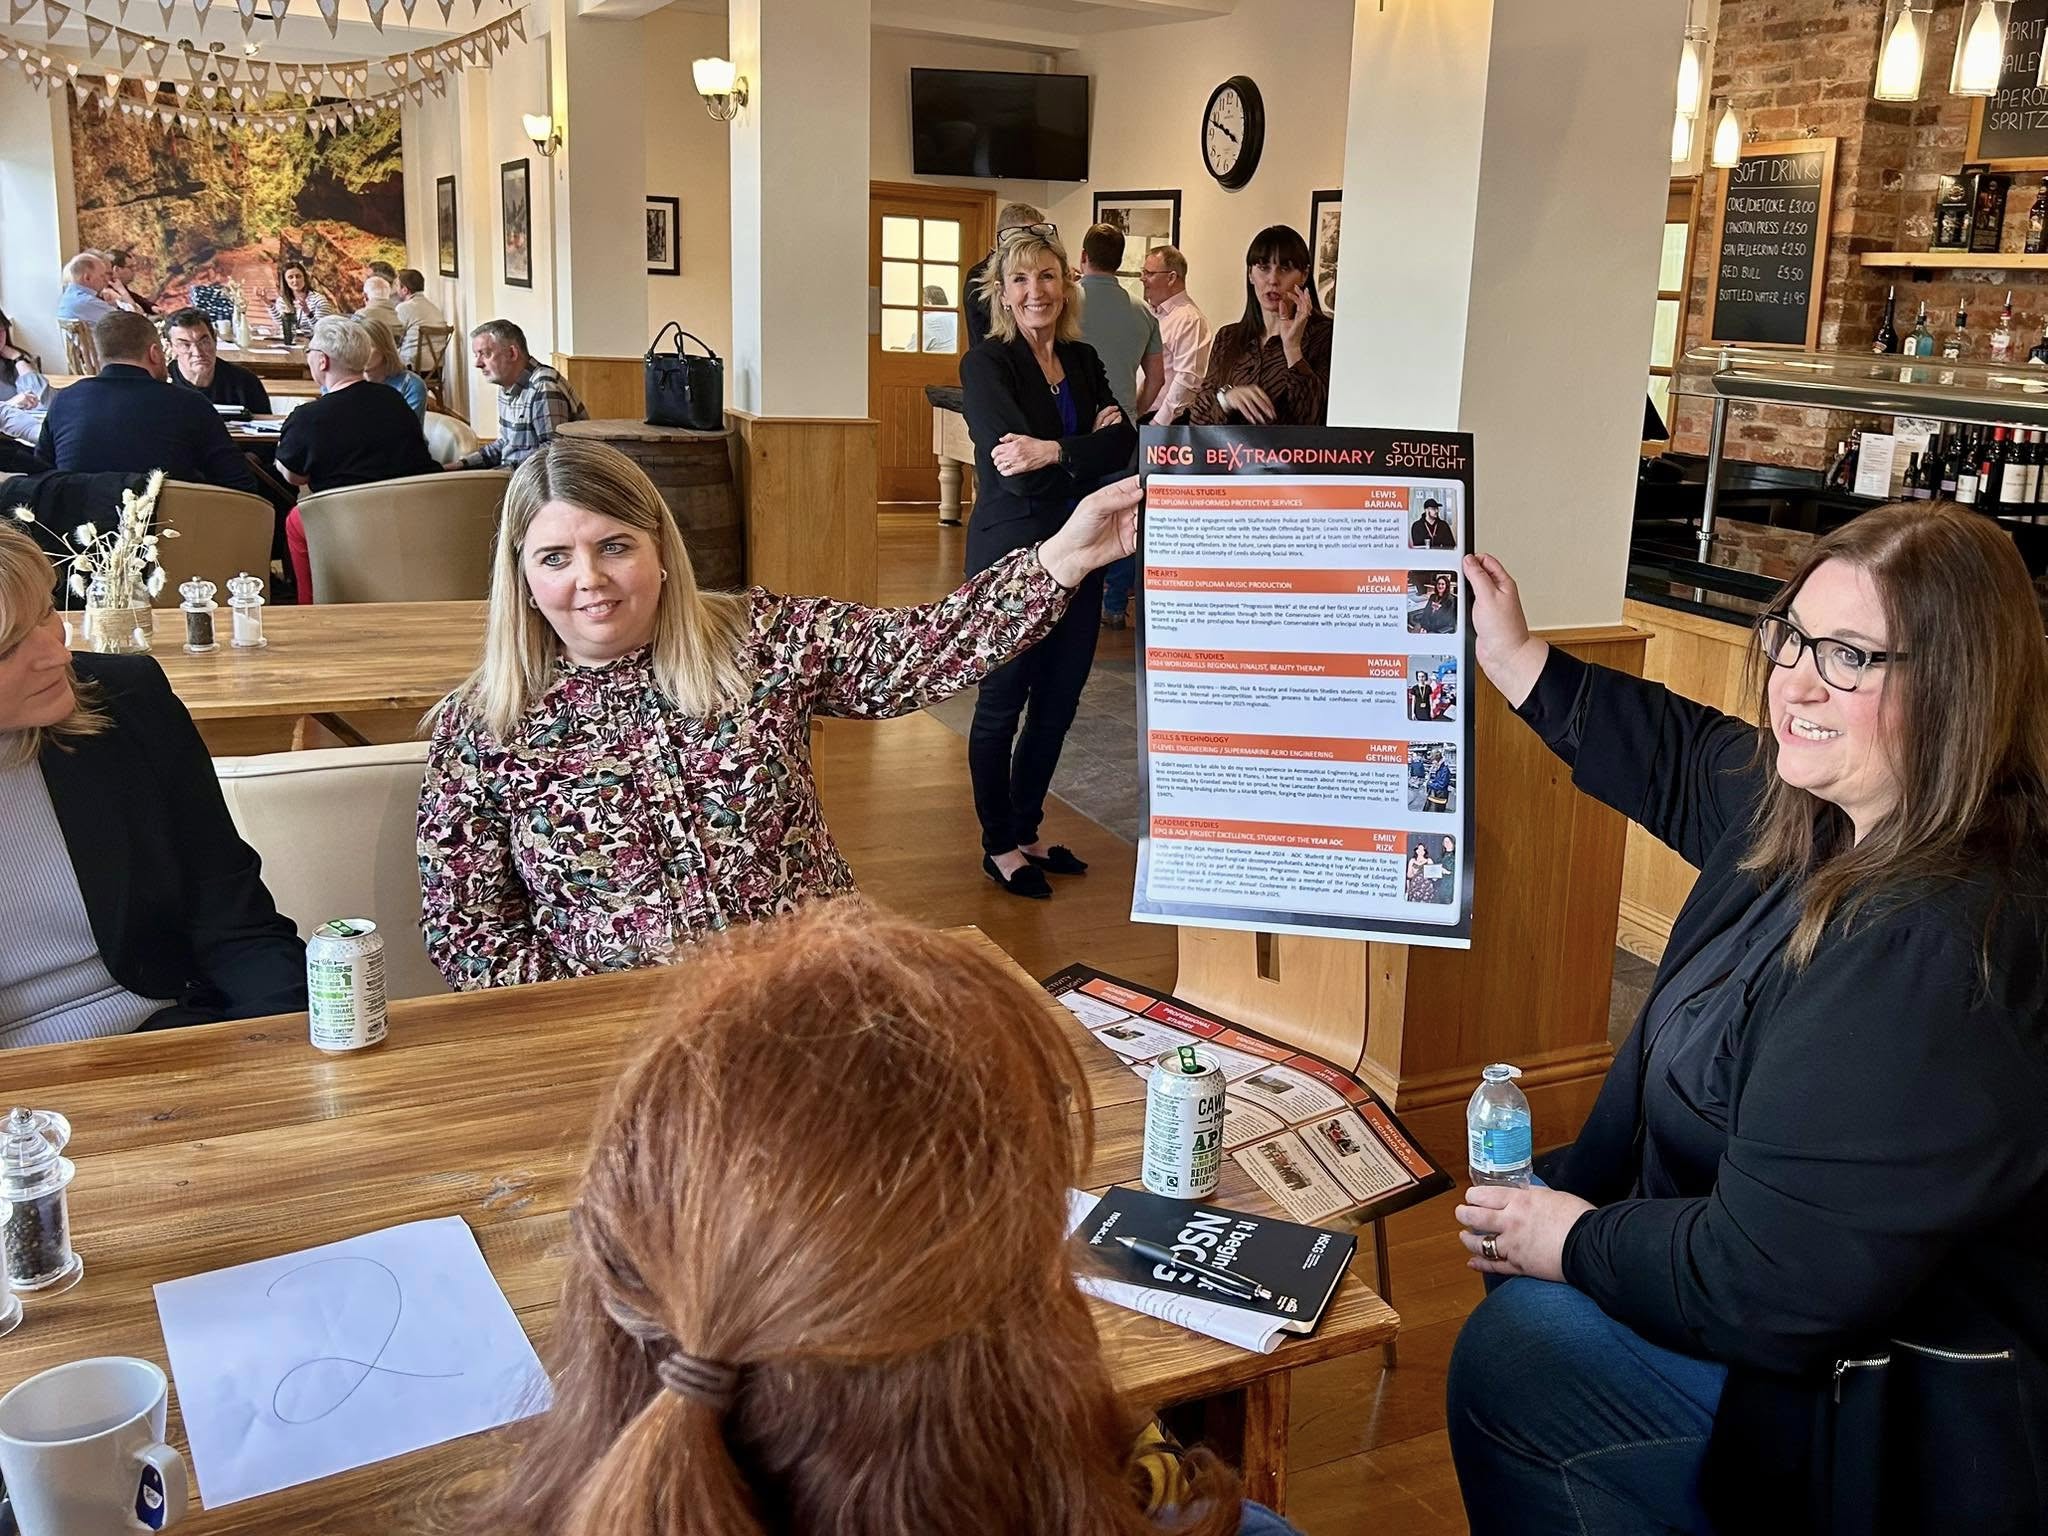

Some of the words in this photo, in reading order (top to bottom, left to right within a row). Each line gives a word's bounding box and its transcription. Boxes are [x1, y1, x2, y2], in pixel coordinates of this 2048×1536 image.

[1990, 87, 2048, 109] APEROL
[1989, 110, 2048, 131] SPRITZ
[1735, 160, 1767, 182] SOFT
[1770, 158, 1820, 181] DRINKS
[1756, 221, 1779, 235] PRESS
[1721, 264, 1739, 279] RED
[1741, 266, 1761, 279] BULL
[1719, 288, 1754, 302] BOTTLED
[1754, 291, 1780, 304] WATER
[1391, 442, 1460, 457] STUDENT
[1146, 445, 1194, 466] NSCG
[1206, 441, 1375, 471] BEXTRAORDINARY
[1385, 454, 1466, 470] SPOTLIGHT
[1196, 488, 1226, 496] STUDIES
[1370, 490, 1397, 499] LEWIS
[1364, 500, 1403, 510] BARIANA
[1367, 575, 1391, 583] LANA
[1195, 580, 1225, 588] DIPLOMA
[1357, 585, 1401, 593] MEECHAM
[1149, 651, 1192, 659] VOCATIONAL
[1207, 662, 1239, 670] REGIONAL
[1367, 659, 1401, 667] NATALIA
[1369, 669, 1400, 677] KOSIOK
[1151, 733, 1174, 741] SKILLS
[1180, 735, 1229, 743] TECHNOLOGY
[1271, 749, 1289, 757] AERO
[1290, 750, 1334, 758] ENGINEERING
[1370, 745, 1398, 753] HARRY
[1365, 754, 1402, 763] GETHING
[1154, 819, 1188, 827] ACADEMIC
[1190, 821, 1219, 829] STUDIES
[1257, 834, 1285, 842] STUDENT
[1373, 833, 1397, 842] EMILY
[1375, 844, 1394, 852] RIZK
[1385, 1123, 1407, 1149] SKILLS
[1371, 1117, 1414, 1165] TECHNOLOGY
[1311, 1233, 1332, 1257] NSCG
